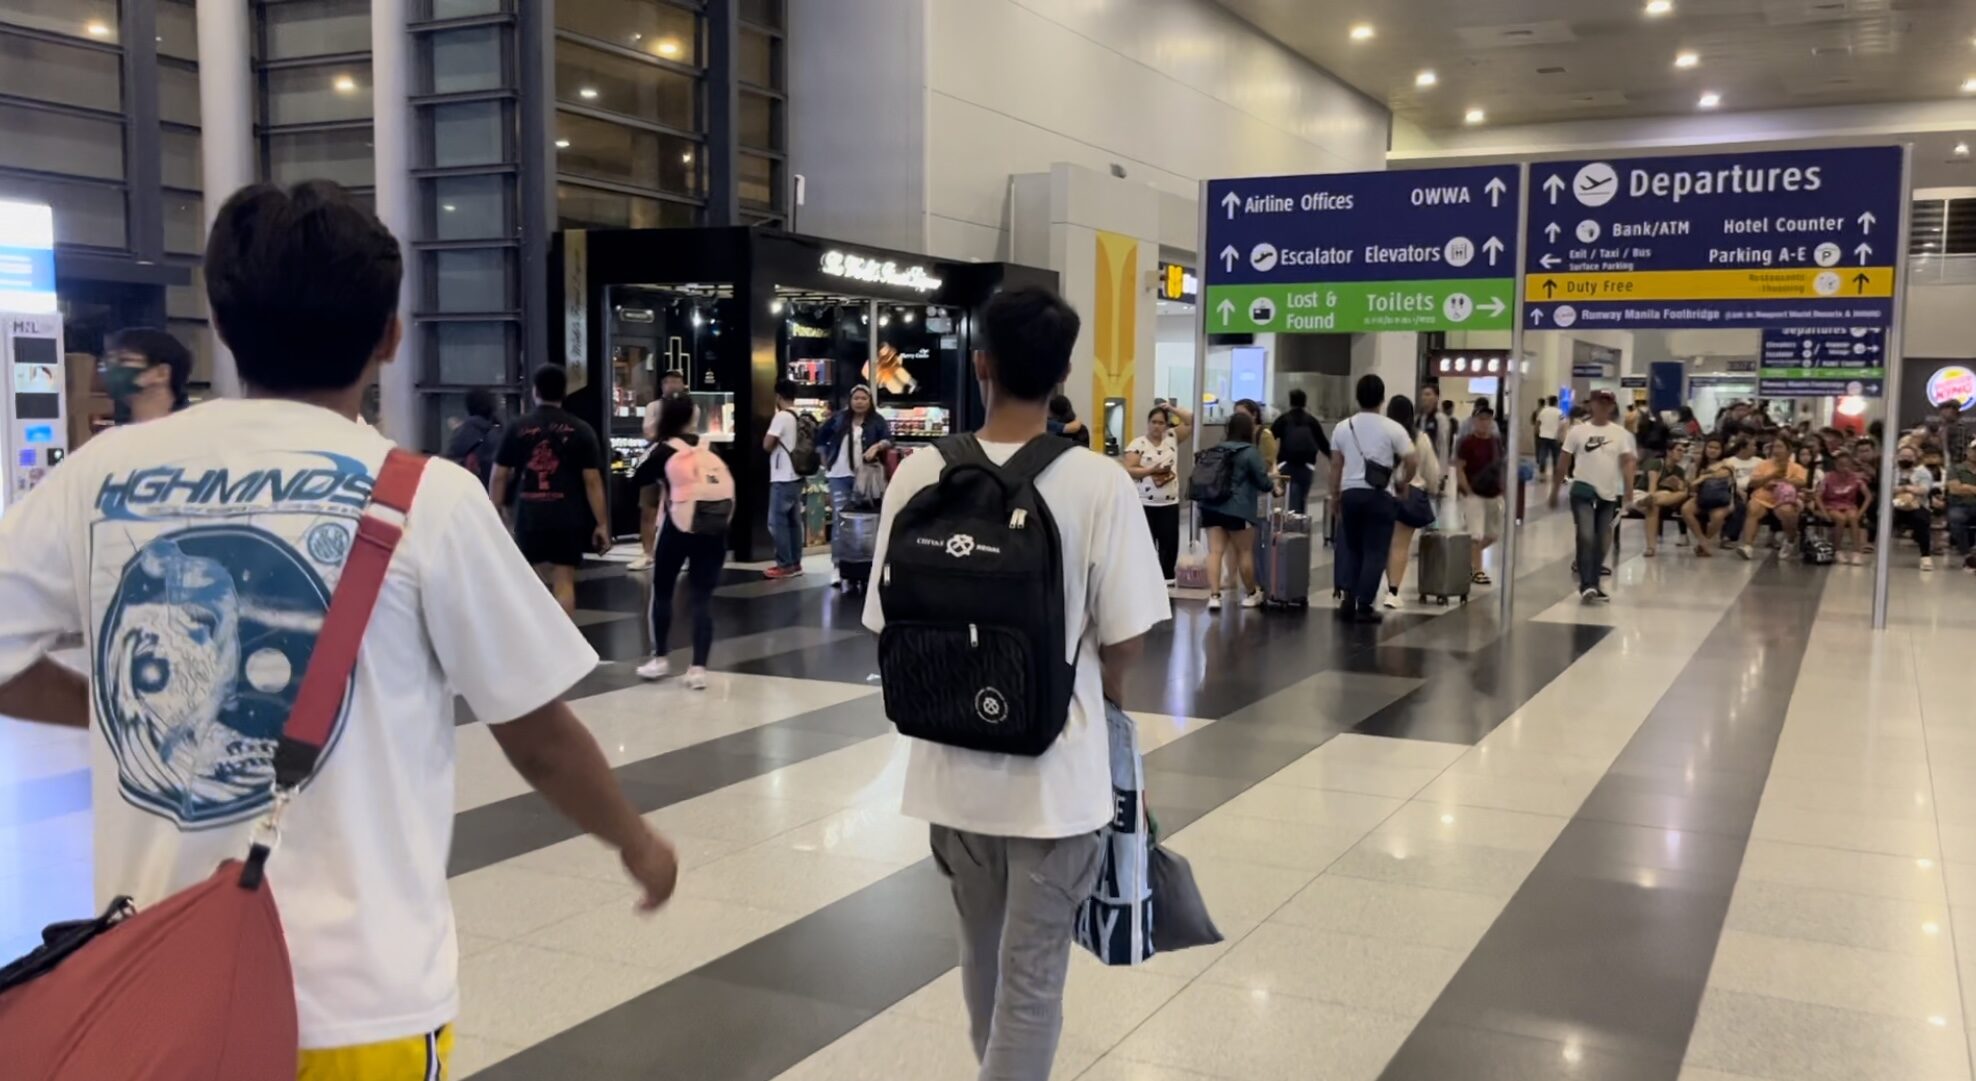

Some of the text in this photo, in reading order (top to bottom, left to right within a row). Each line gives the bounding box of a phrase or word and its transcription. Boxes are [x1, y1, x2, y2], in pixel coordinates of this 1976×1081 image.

[1629, 164, 1822, 203] Departures
[1245, 192, 1354, 215] Airline Offices
[1411, 186, 1471, 206] OWWA
[1612, 220, 1690, 238] Bank/ATM
[1723, 216, 1844, 234] Hotel Counter
[1281, 248, 1353, 266] Escalator
[1365, 246, 1441, 263] Elevators
[1569, 249, 1587, 259] Exit
[1600, 248, 1620, 258] Taxi
[1632, 248, 1651, 257] Bus
[1709, 246, 1806, 265] Parking A-E
[1567, 281, 1633, 295] Duty Free
[1287, 291, 1337, 308] Lost &
[1366, 292, 1434, 311] Toilets
[1287, 312, 1334, 329] Found
[1582, 310, 1622, 321] Runway
[1624, 309, 1660, 320] Manila
[1663, 308, 1720, 321] Footbridge
